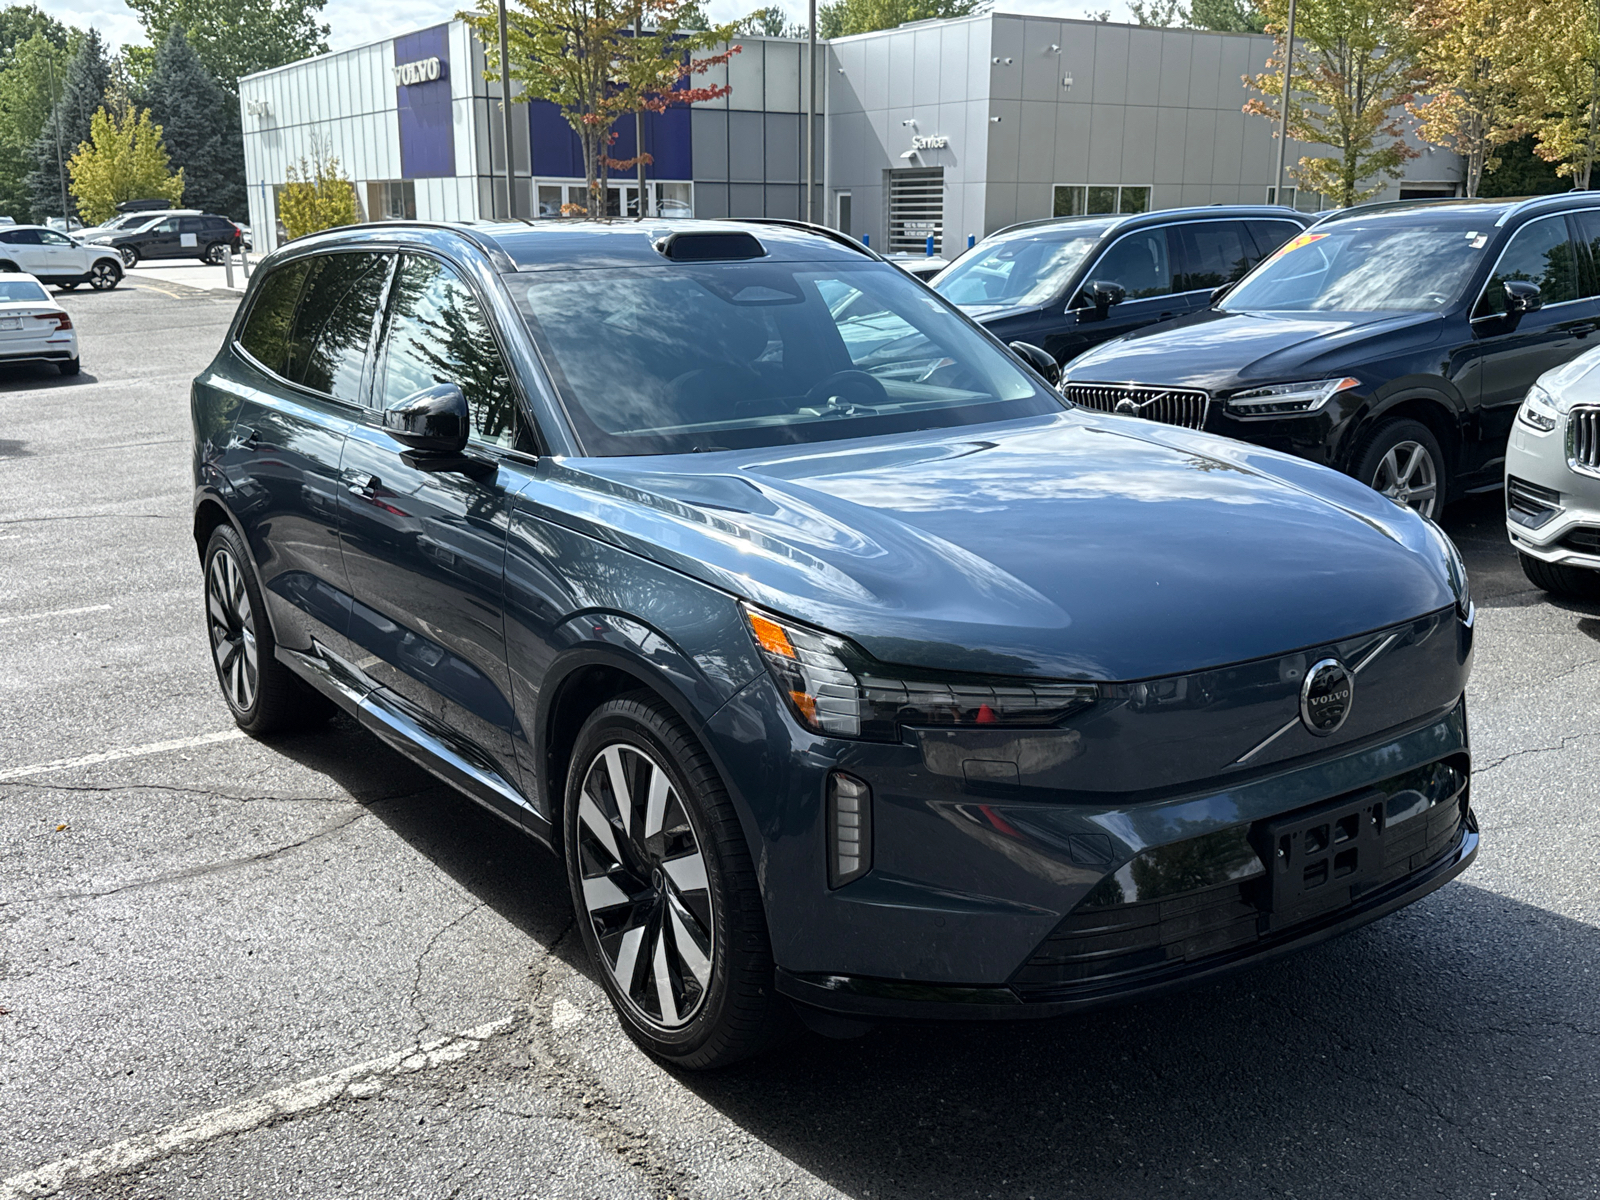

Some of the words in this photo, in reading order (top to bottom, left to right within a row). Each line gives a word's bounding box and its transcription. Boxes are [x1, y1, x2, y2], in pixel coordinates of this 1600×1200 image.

[392, 57, 440, 86] VOLVO
[912, 134, 947, 149] Service
[1310, 690, 1349, 706] VOLVO
